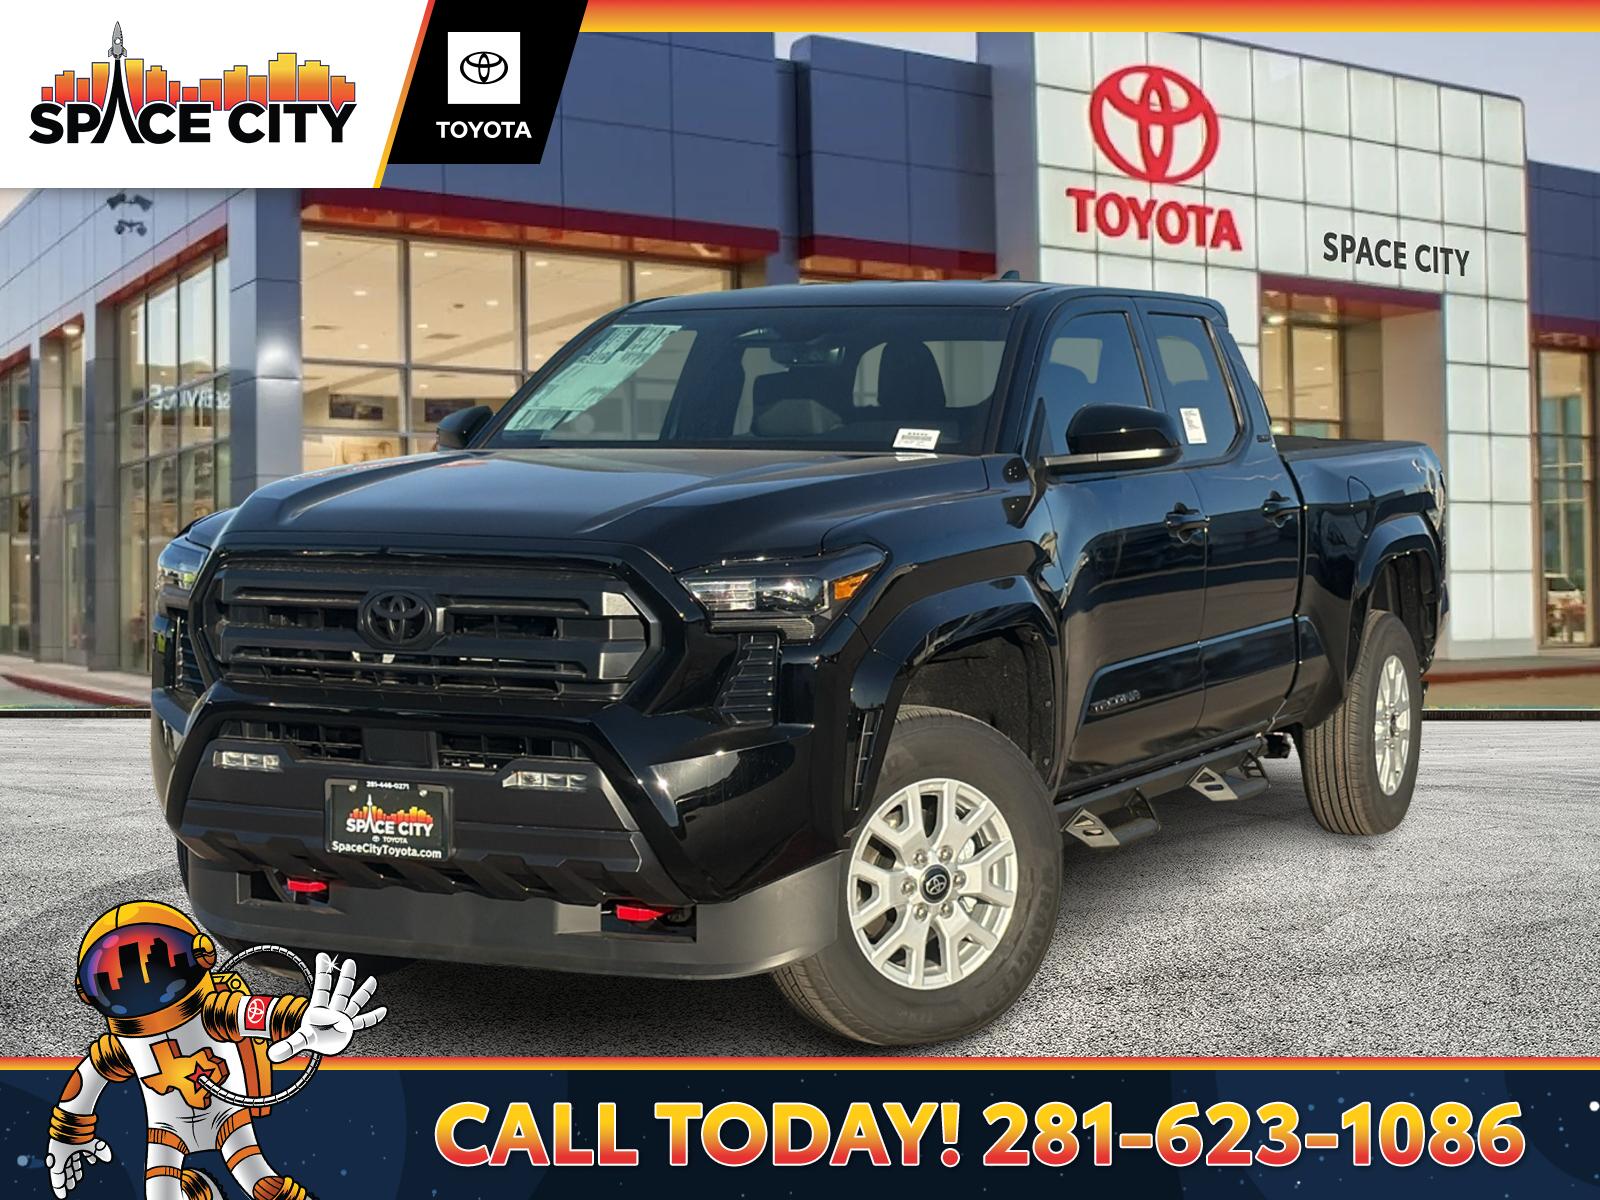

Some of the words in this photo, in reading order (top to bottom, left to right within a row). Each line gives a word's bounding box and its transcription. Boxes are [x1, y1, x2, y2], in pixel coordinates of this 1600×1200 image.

[1066, 188, 1242, 251] TOYOTA
[1323, 233, 1406, 269] SPACE
[1415, 244, 1469, 276] CITY
[346, 810, 394, 834] SPACE
[398, 821, 434, 837] CITY
[332, 841, 442, 859] SpaceCityToyota.com
[383, 836, 408, 844] TOYOTA
